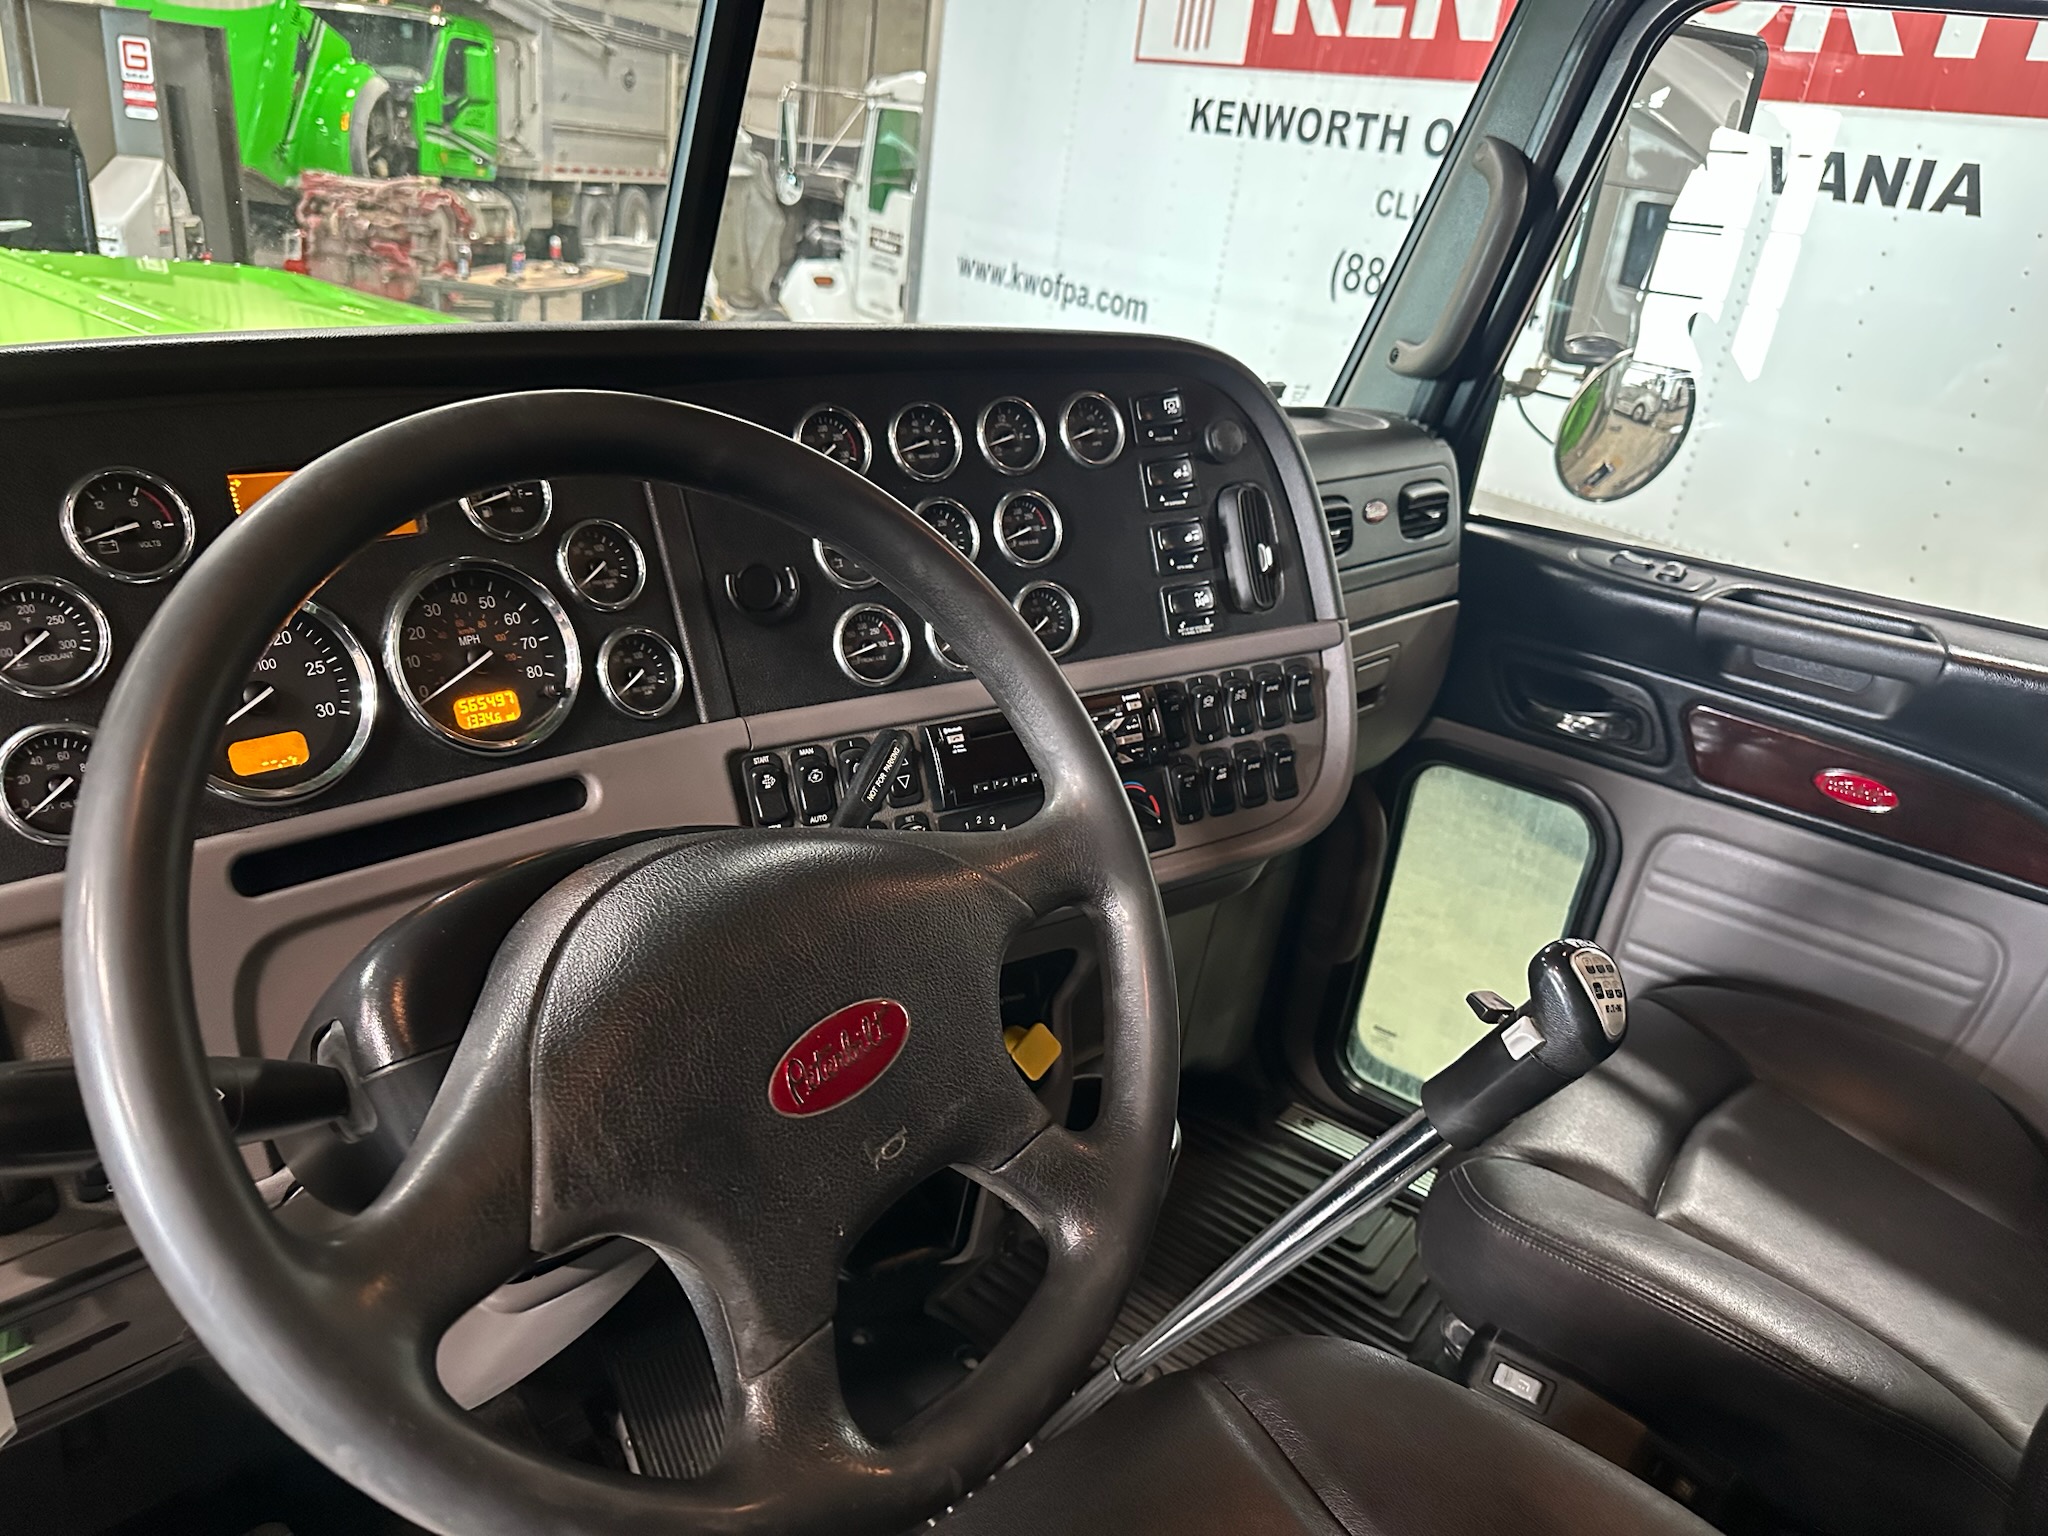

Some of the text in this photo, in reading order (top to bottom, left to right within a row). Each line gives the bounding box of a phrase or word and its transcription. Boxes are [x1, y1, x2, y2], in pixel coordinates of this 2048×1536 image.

[1190, 97, 1409, 155] KENWORTH
[956, 255, 1149, 325] www.kwofpa.com
[94, 500, 105, 510] 12
[128, 497, 139, 507] 15
[152, 520, 163, 530] 18
[139, 539, 162, 549] VOLTS
[450, 591, 468, 605] 40
[478, 595, 496, 610] 50
[16, 604, 36, 615] 200
[423, 602, 442, 618] 30
[46, 614, 65, 626] 250
[503, 612, 521, 626] 60
[273, 630, 292, 646] 20
[407, 625, 426, 641] 20
[58, 639, 77, 650] 300
[457, 635, 481, 647] MPH
[519, 636, 538, 650] 70
[38, 651, 74, 663] COOLANT
[405, 654, 421, 669] 10
[304, 660, 326, 677] 25
[526, 664, 543, 679] 80
[418, 684, 430, 698] 0
[314, 701, 336, 718] 30
[458, 692, 515, 714] 565497
[56, 750, 70, 761] 60
[798, 747, 815, 756] MAN
[29, 755, 43, 766] 40
[753, 755, 770, 765] START
[17, 774, 31, 785] 20
[866, 746, 901, 802] NOT FOR PARKING
[809, 813, 828, 824] AUTO
[785, 1007, 892, 1107] Peterbilt
